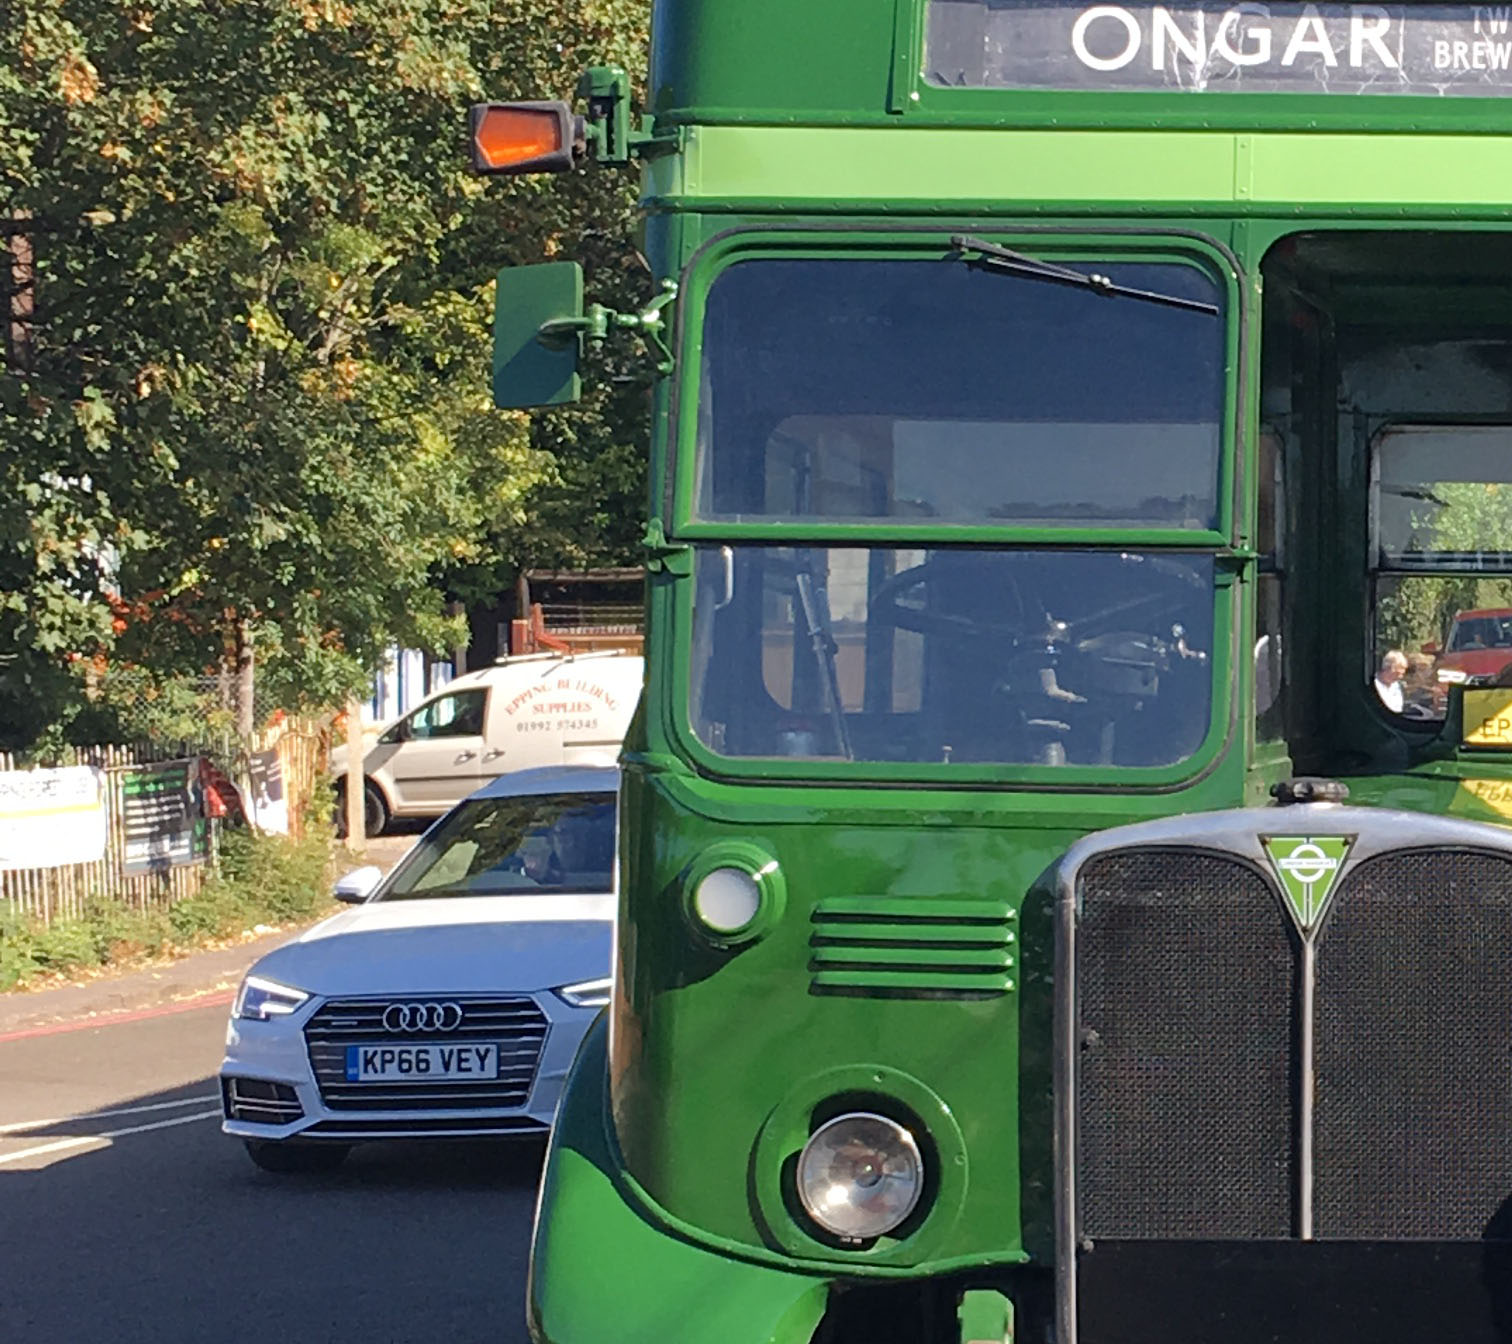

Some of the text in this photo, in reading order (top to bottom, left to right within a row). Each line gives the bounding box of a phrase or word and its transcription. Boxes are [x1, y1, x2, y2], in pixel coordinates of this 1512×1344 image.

[1071, 1, 1400, 72] ONGAR
[532, 701, 593, 715] SUPPLIES
[363, 1047, 491, 1074] KP66 VEY
